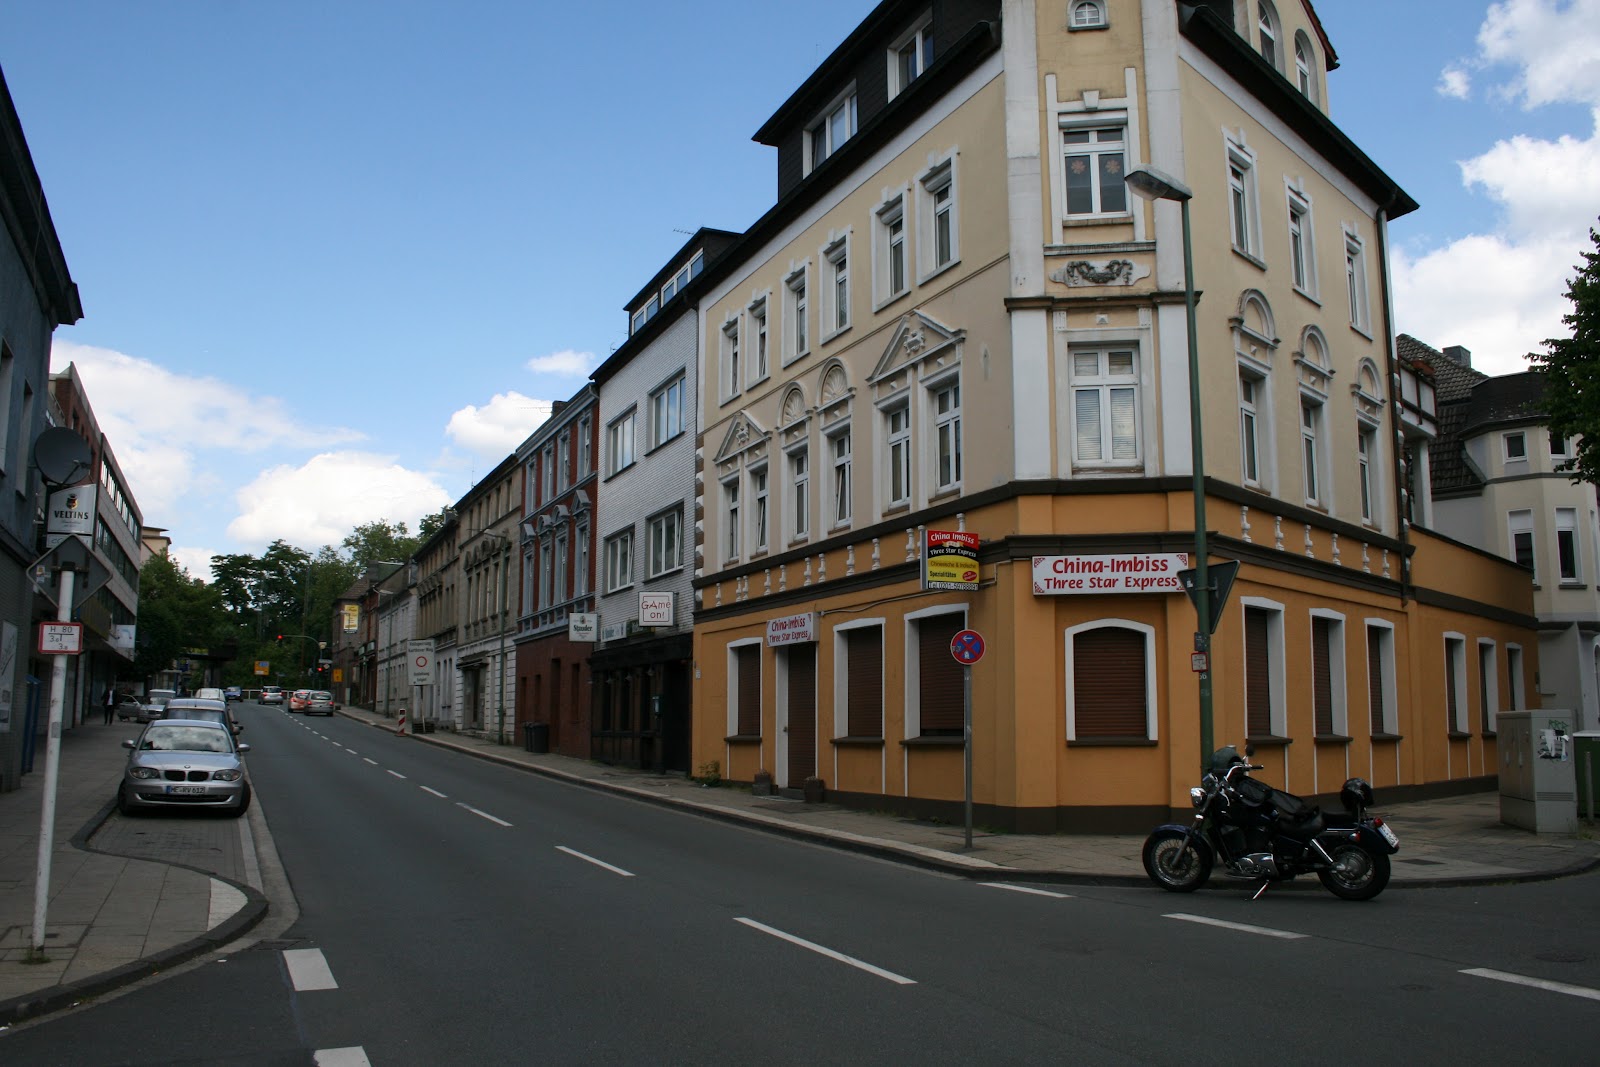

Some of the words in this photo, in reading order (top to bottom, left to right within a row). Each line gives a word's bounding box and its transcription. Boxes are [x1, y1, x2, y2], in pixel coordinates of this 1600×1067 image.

[54, 510, 89, 520] VELTINS
[930, 532, 950, 541] China
[952, 533, 975, 544] Imbiss
[930, 548, 945, 556] Three
[957, 549, 976, 557] Express
[1052, 556, 1169, 574] China-Imbiss
[1044, 577, 1083, 589] Three
[1089, 576, 1119, 589] Star
[1125, 576, 1177, 590] Express
[649, 611, 665, 619] on!
[573, 624, 593, 632] Stauder
[771, 616, 806, 632] China-Imbiss
[769, 634, 781, 643] Three
[791, 630, 808, 641] Express
